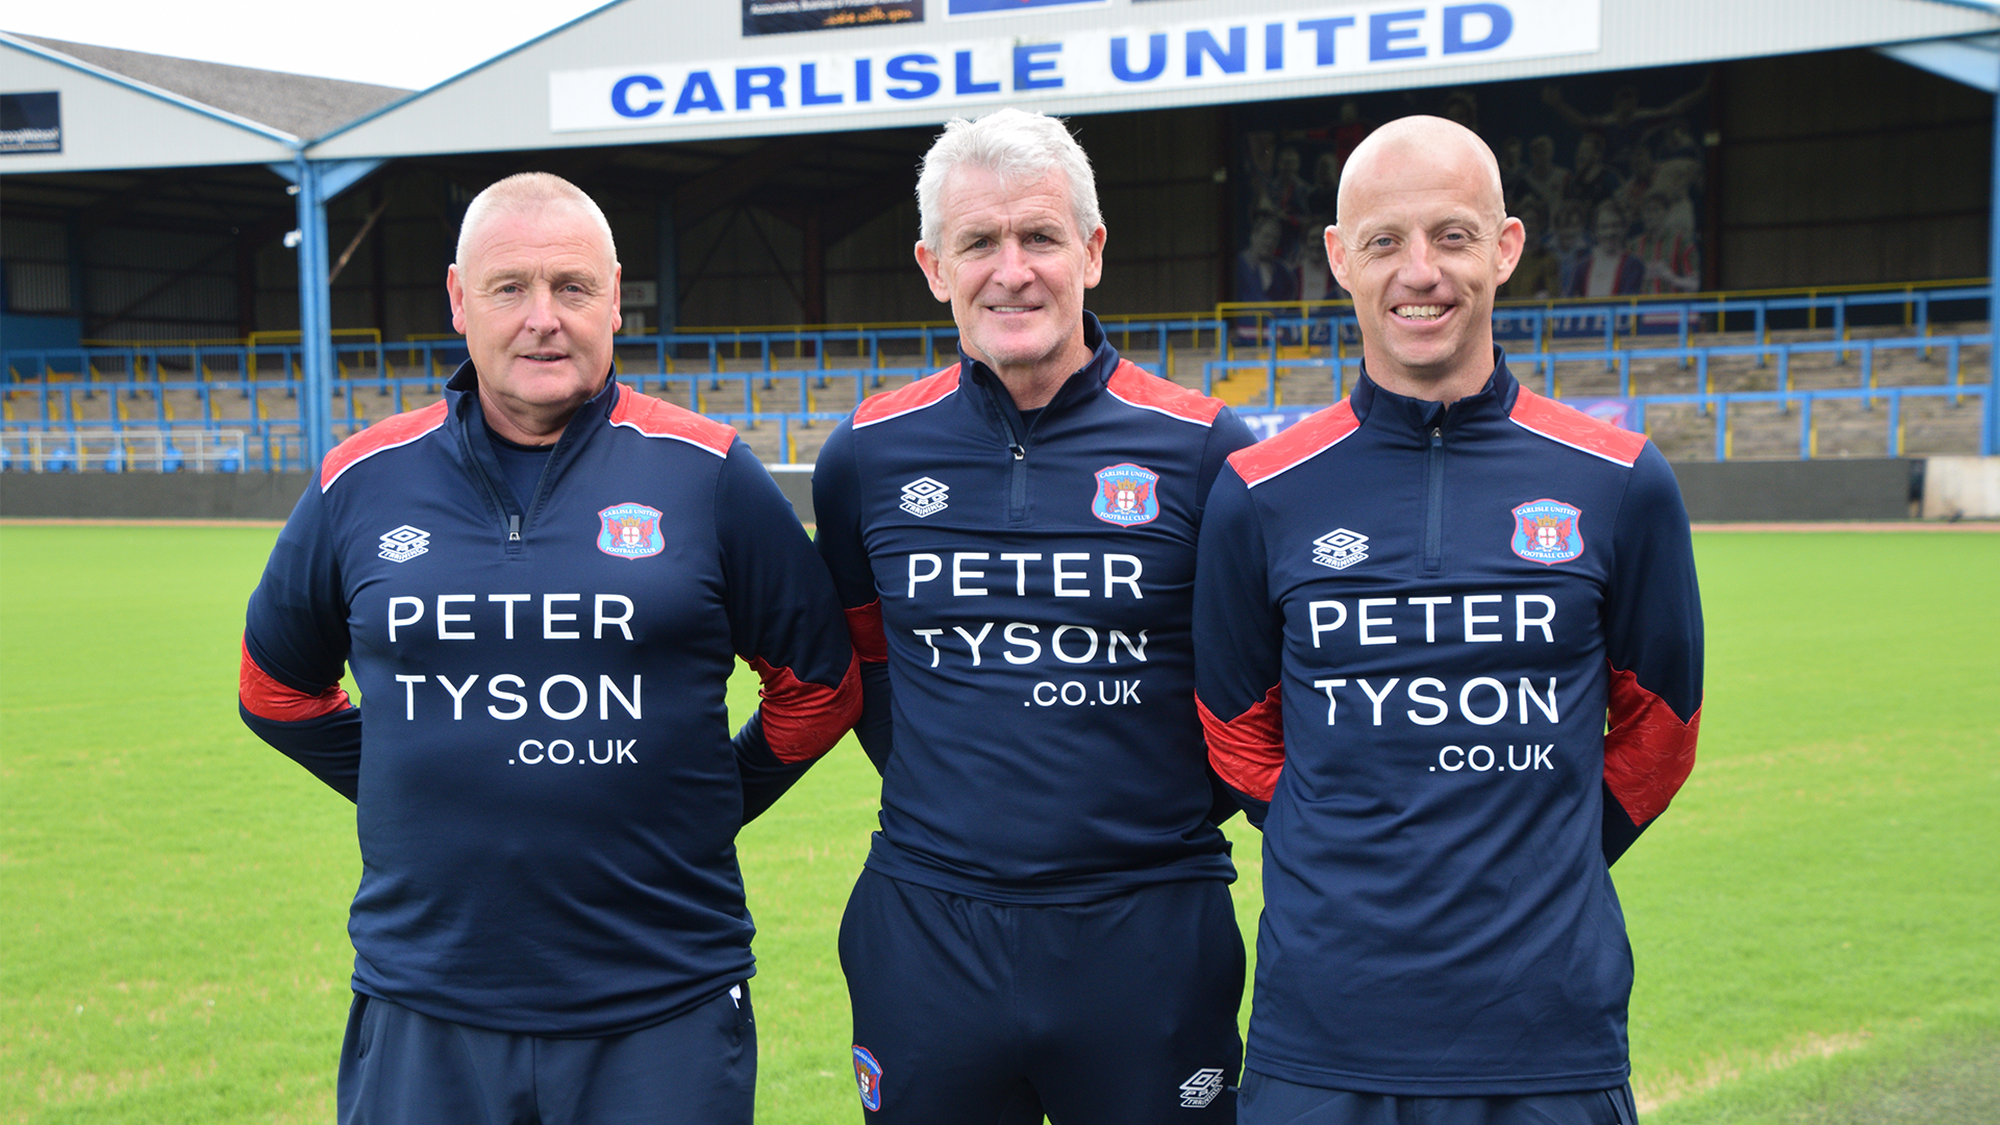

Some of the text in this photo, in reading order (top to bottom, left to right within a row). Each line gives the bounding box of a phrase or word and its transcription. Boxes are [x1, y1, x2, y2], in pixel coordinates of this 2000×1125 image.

[611, 2, 1514, 119] CARLISLE UNITED
[1099, 470, 1155, 481] CARLISLE UNITED
[602, 509, 659, 518] CARLISLE UNITED
[904, 502, 945, 516] TRAINING
[1100, 511, 1133, 521] FOOTBALL
[1516, 506, 1577, 516] CARLISLE UNITED
[382, 546, 427, 561] TRAINING
[605, 546, 639, 554] FOOTBALL
[1318, 552, 1365, 568] TRAINING
[1520, 549, 1556, 559] FOOTBALL
[1556, 551, 1575, 559] CLUB
[908, 553, 1143, 599] PETER
[389, 594, 634, 642] PETER
[1309, 595, 1555, 648] PETER
[913, 623, 1147, 667] TYSON
[396, 674, 641, 720] TYSON
[1024, 680, 1141, 706] .CO.UK
[1314, 677, 1558, 725] TYSON
[509, 740, 637, 764] .CO.UK
[1430, 744, 1554, 771] .CO.UK
